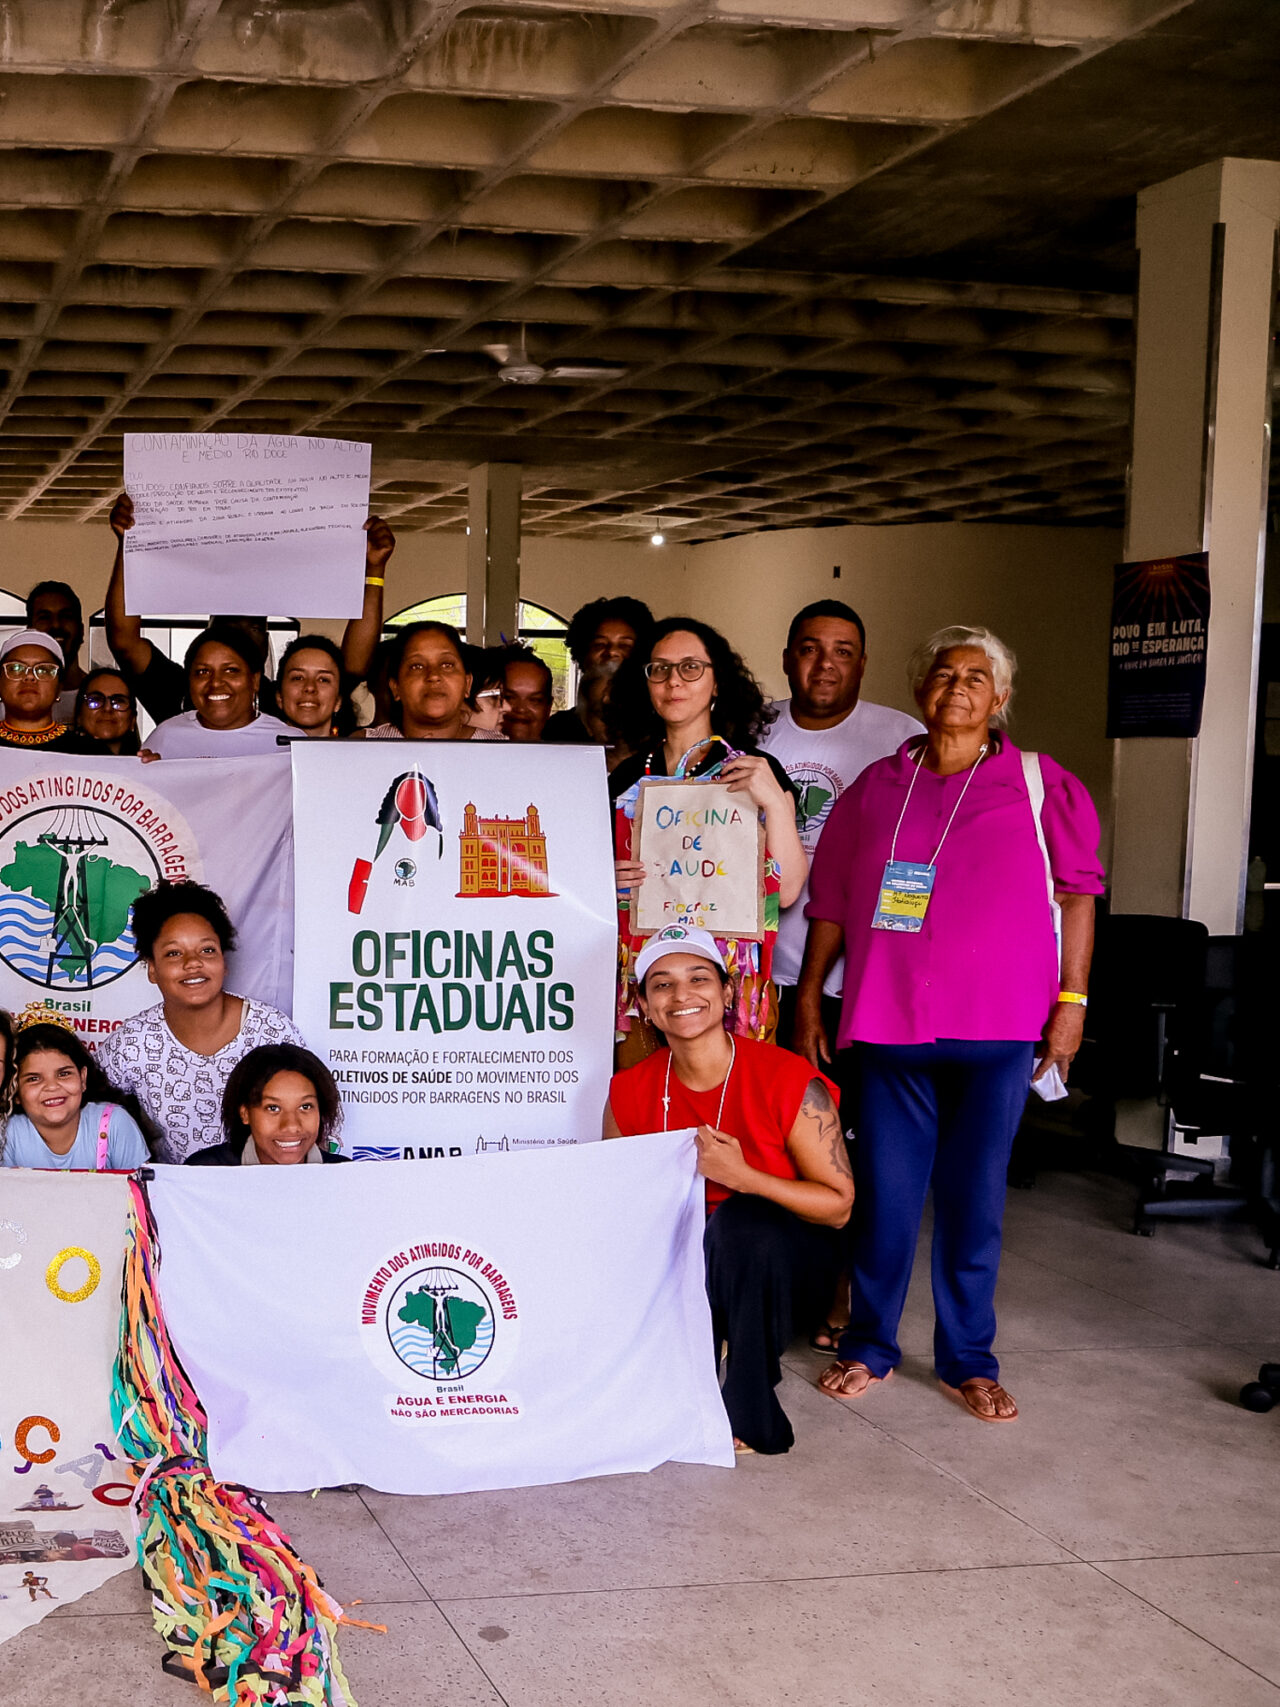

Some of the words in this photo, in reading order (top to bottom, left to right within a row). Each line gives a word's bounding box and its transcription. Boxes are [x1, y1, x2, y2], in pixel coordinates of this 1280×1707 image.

[236, 435, 258, 450] DA
[308, 438, 325, 450] NO
[333, 440, 363, 453] ALTO
[182, 450, 190, 463] E
[242, 448, 259, 459] RIO
[264, 448, 288, 459] DOCE
[1112, 624, 1140, 640] POVO
[1146, 622, 1167, 637] EM
[1172, 618, 1205, 635] LUTA.
[1112, 642, 1130, 656] RIO
[1141, 636, 1205, 655] ESPERANÇA
[656, 805, 743, 829] OFICINA
[29, 776, 114, 802] ATINGIDOS
[111, 787, 140, 818] POR
[135, 807, 187, 884] BARRAGEN
[682, 835, 703, 851] DE
[393, 878, 415, 887] MAB
[678, 915, 705, 928] MAB
[351, 929, 554, 982] OFICINAS
[43, 997, 91, 1013] Brasil
[328, 981, 575, 1035] ESTADUAIS
[329, 1049, 359, 1063] PARA
[361, 1049, 429, 1067] FORMAÇÃO
[432, 1050, 440, 1064] E
[442, 1050, 545, 1064] FORTALECIMENTO
[548, 1050, 574, 1064] DOS
[331, 1069, 389, 1083] OLETIVOS
[392, 1071, 408, 1083] DE
[411, 1068, 452, 1084] SAÚDE
[456, 1071, 473, 1083] DO
[476, 1070, 550, 1083] MOVIMENTO
[554, 1070, 579, 1083] DOS
[402, 1090, 426, 1104] POR
[429, 1090, 501, 1104] BARRAGENS
[504, 1090, 522, 1104] NO
[527, 1090, 567, 1104] BRASIL
[361, 1266, 393, 1325] MOVIMENTO
[387, 1252, 410, 1273] DOS
[408, 1242, 462, 1262] ATINGIDOS
[462, 1249, 485, 1269] POR
[480, 1263, 518, 1321] BARRAGENS
[436, 1384, 464, 1393] Brasil
[396, 1394, 433, 1406] ÁGUA
[436, 1396, 445, 1405] E
[448, 1394, 508, 1404] ENERGIA
[390, 1408, 413, 1418] NÃO
[415, 1408, 437, 1418] SÃO
[439, 1406, 519, 1417] MERCADORIAS
[0, 1537, 35, 1546] RIOS
